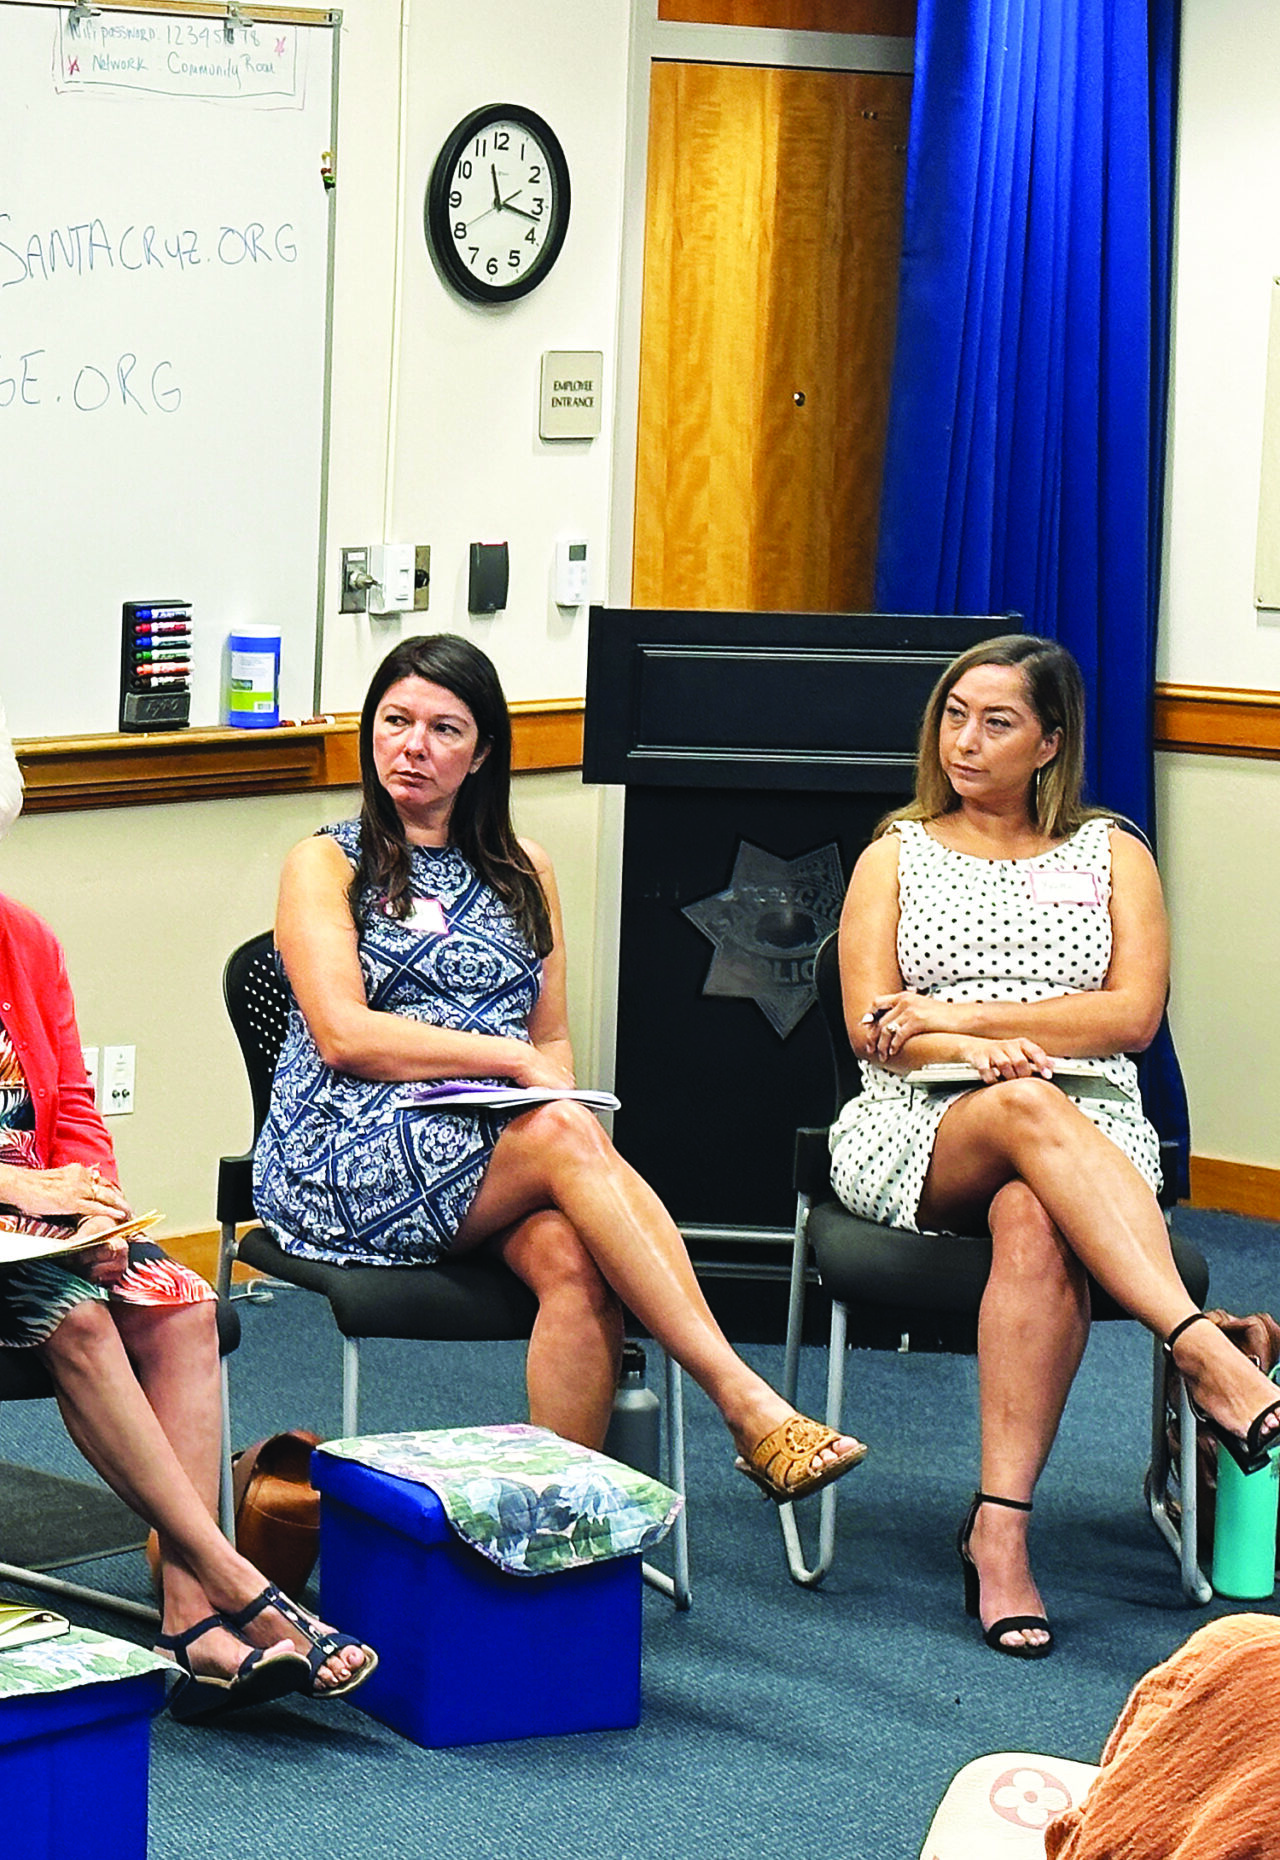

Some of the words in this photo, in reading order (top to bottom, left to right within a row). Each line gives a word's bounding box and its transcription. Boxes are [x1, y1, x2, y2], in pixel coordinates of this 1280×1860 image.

[166, 24, 261, 48] 1234578
[475, 138, 487, 157] 11
[493, 131, 510, 151] 12
[458, 160, 473, 179] 10
[528, 165, 542, 184] 2
[449, 191, 462, 208] 9
[531, 198, 544, 216] 3
[453, 222, 467, 239] 8
[524, 226, 536, 244] 4
[468, 246, 480, 264] 7
[507, 250, 521, 267] 5
[486, 257, 498, 275] 6
[551, 396, 594, 408] ENTRANCE
